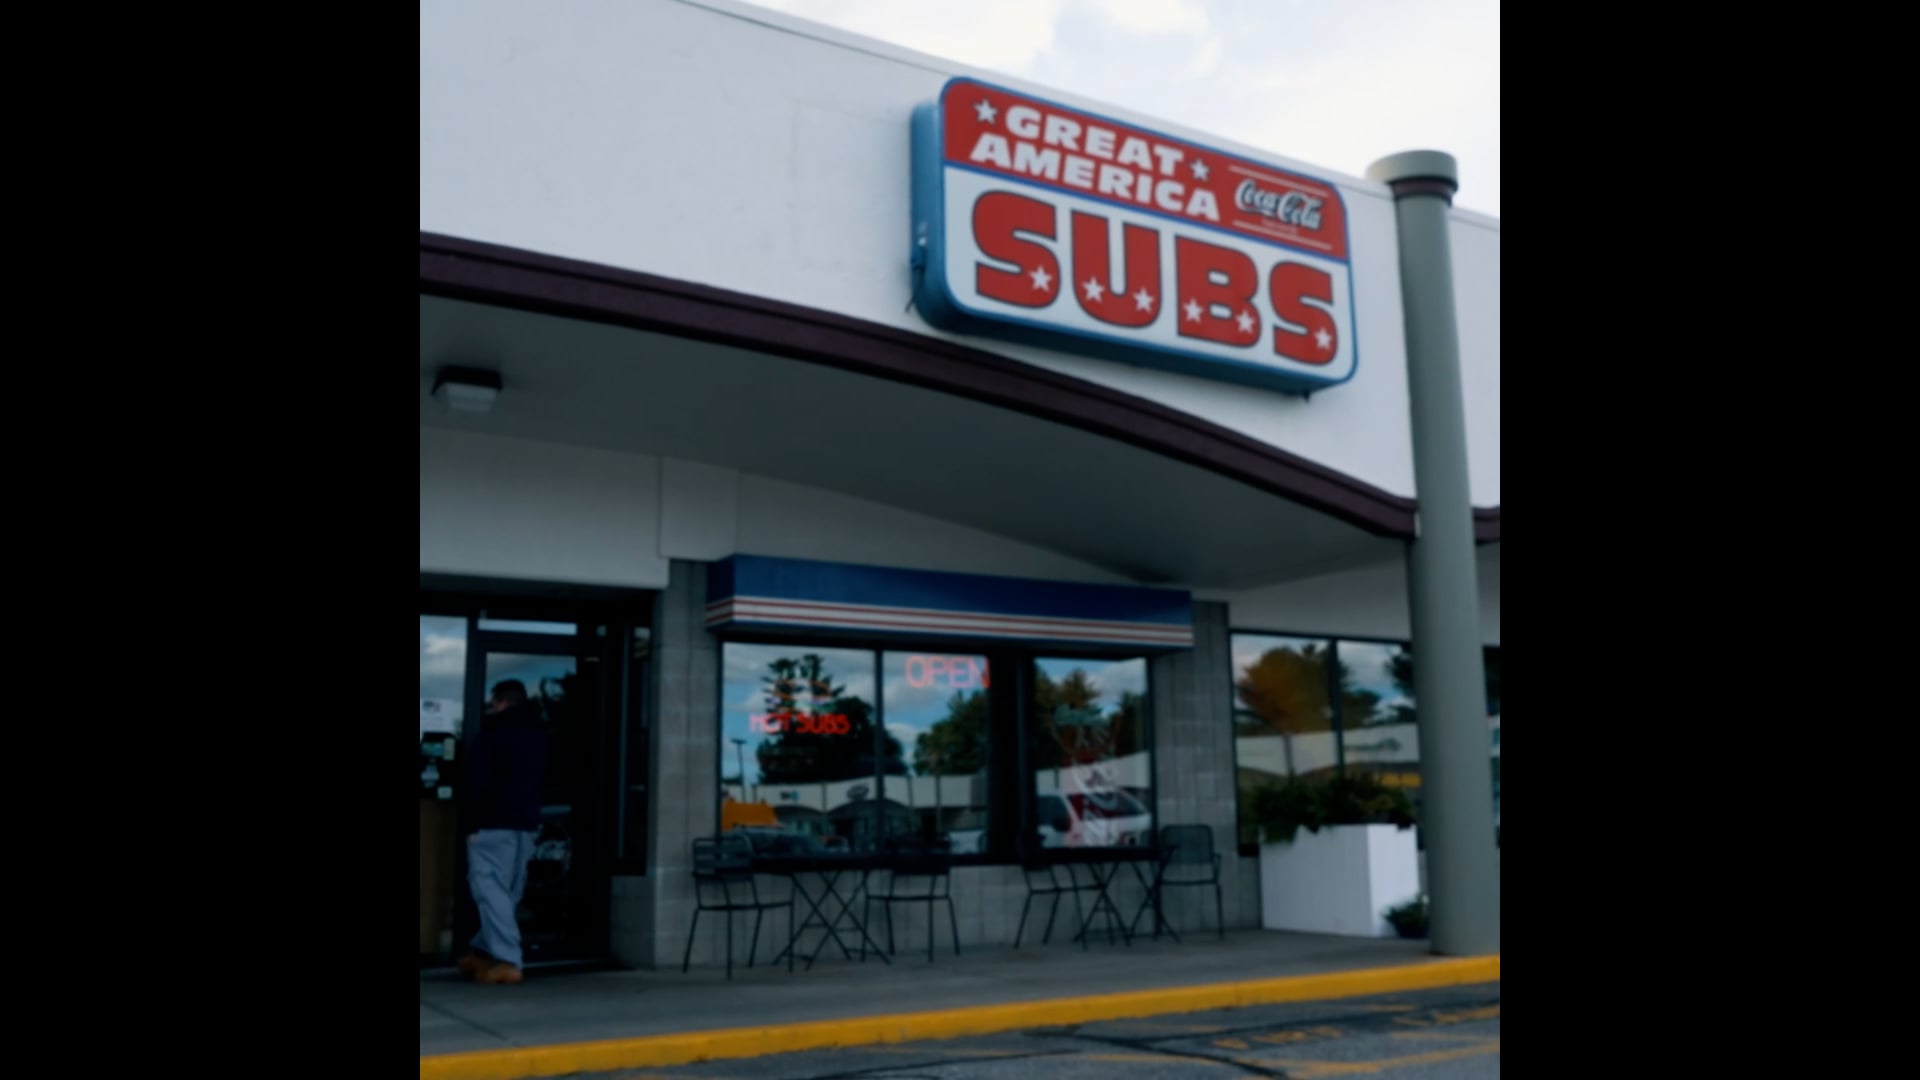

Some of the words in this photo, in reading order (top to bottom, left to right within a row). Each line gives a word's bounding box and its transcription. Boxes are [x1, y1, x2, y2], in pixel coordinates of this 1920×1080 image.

[970, 132, 1221, 222] AMERICA
[1005, 105, 1184, 177] GREAT
[972, 189, 1339, 367] SUBS
[904, 655, 992, 689] OPEN
[750, 712, 791, 734] HOT
[795, 712, 851, 735] SUBS
